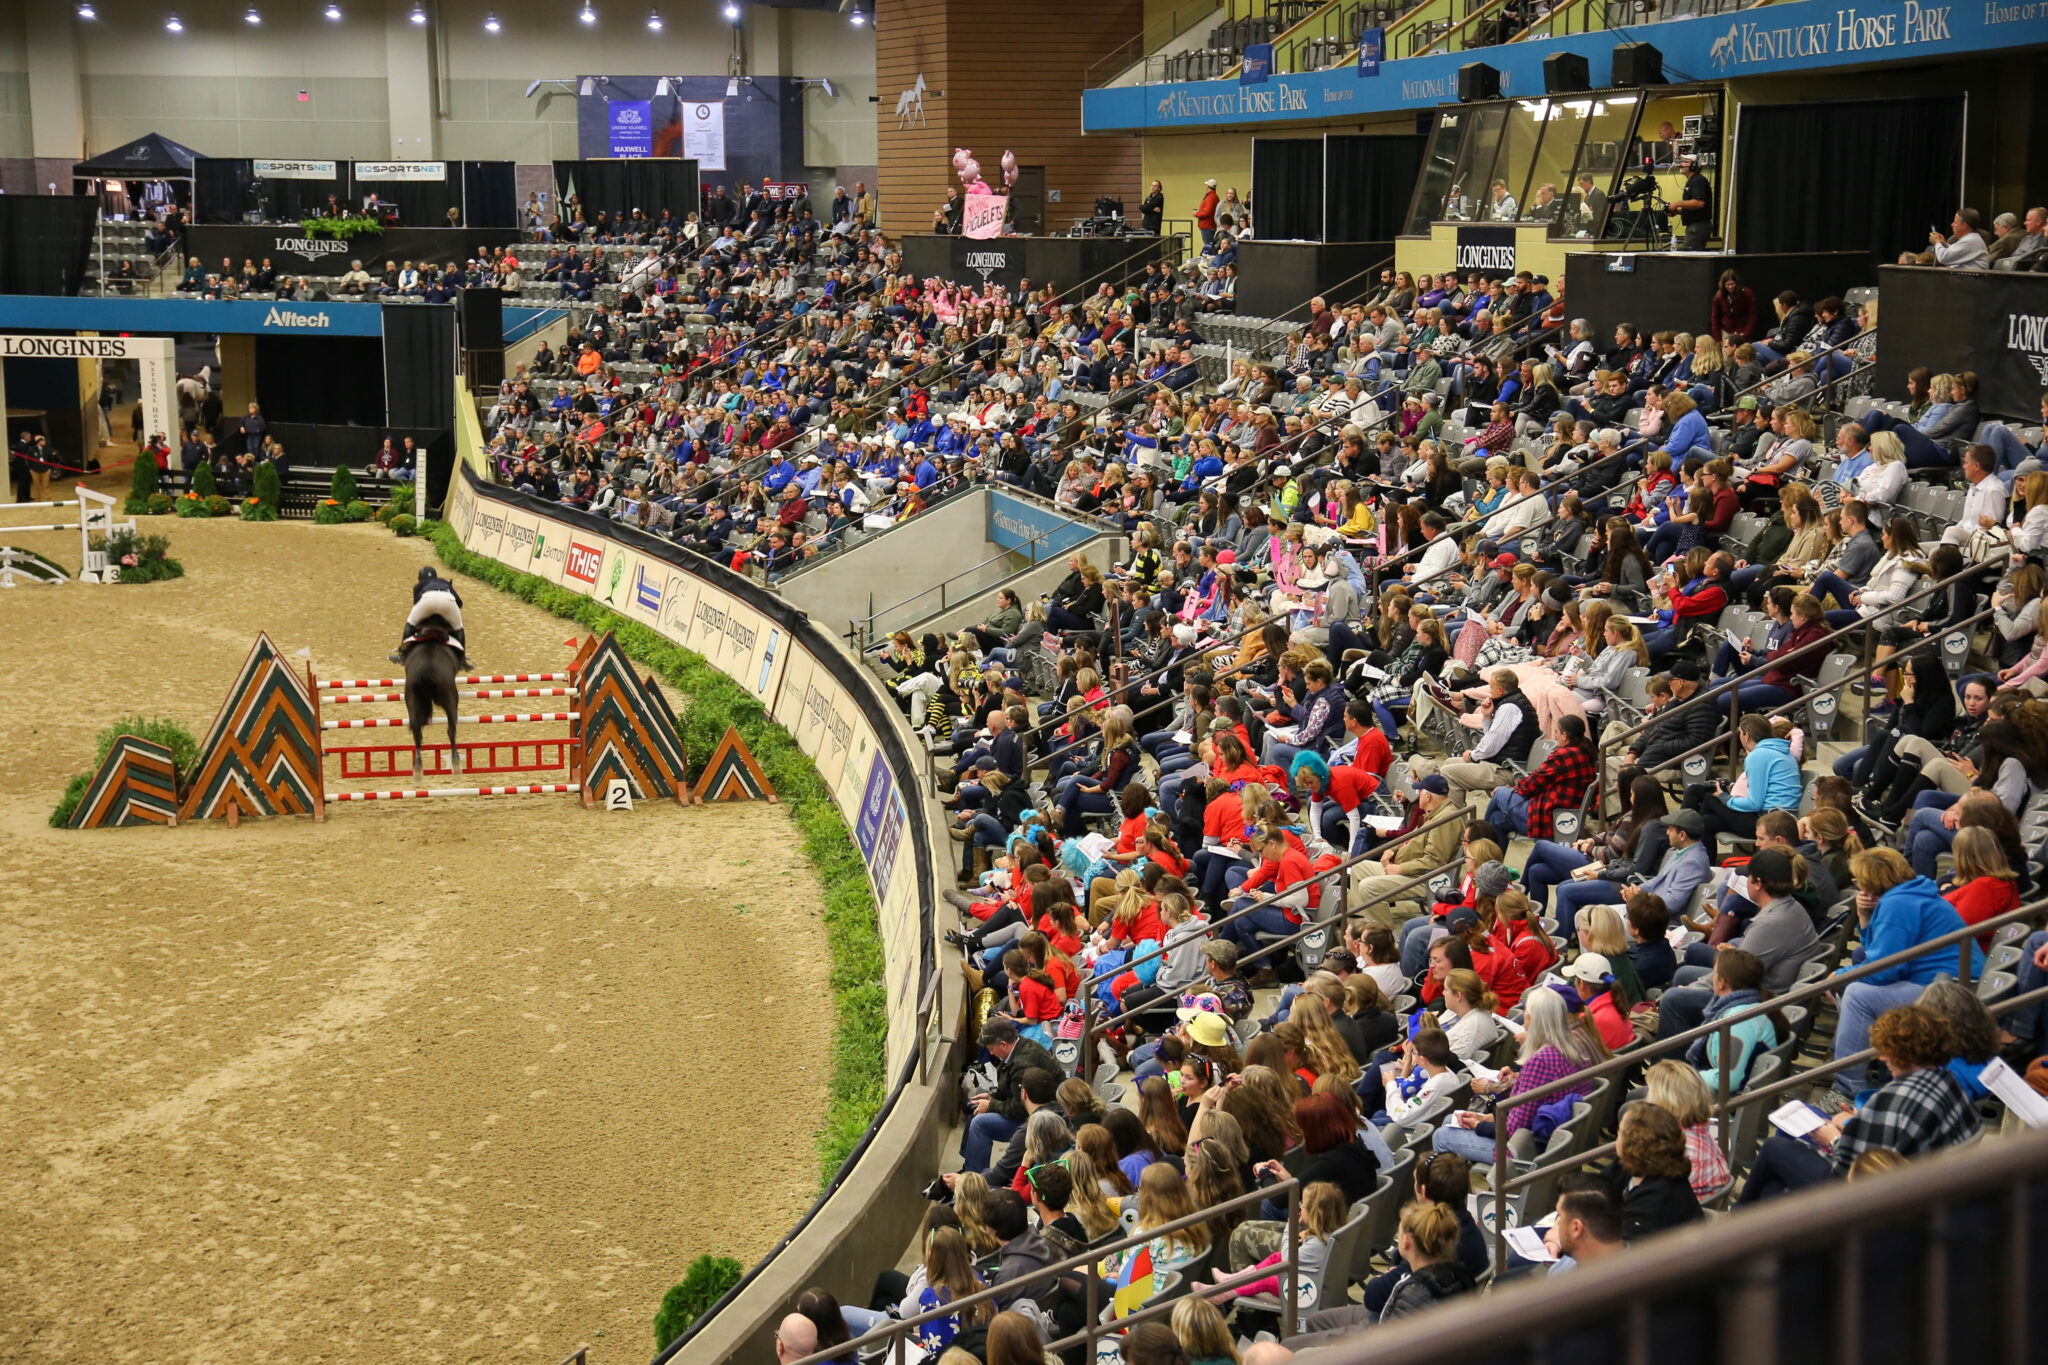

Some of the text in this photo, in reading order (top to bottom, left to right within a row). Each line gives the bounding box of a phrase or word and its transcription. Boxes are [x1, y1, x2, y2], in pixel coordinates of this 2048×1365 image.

[1984, 2, 2020, 25] HOME
[2022, 4, 2036, 20] OF
[1740, 0, 1951, 63] KENTUCKY HORSE PARK
[1177, 83, 1308, 118] KENTUCKY HORSE PARK
[1402, 78, 1446, 100] NATIONAL
[275, 237, 349, 253] LONGINES
[966, 252, 1006, 268] LONGINES
[1457, 245, 1515, 271] LONGINES
[263, 306, 330, 328] Alltech
[5, 337, 126, 357] LONGINES
[475, 511, 504, 534] LONGINES
[505, 521, 535, 545] LONGINES
[110, 569, 120, 580] 3
[570, 546, 600, 580] THIS
[696, 600, 726, 632] LONGINES
[725, 617, 755, 651] LONGINES
[612, 787, 627, 805] 2
